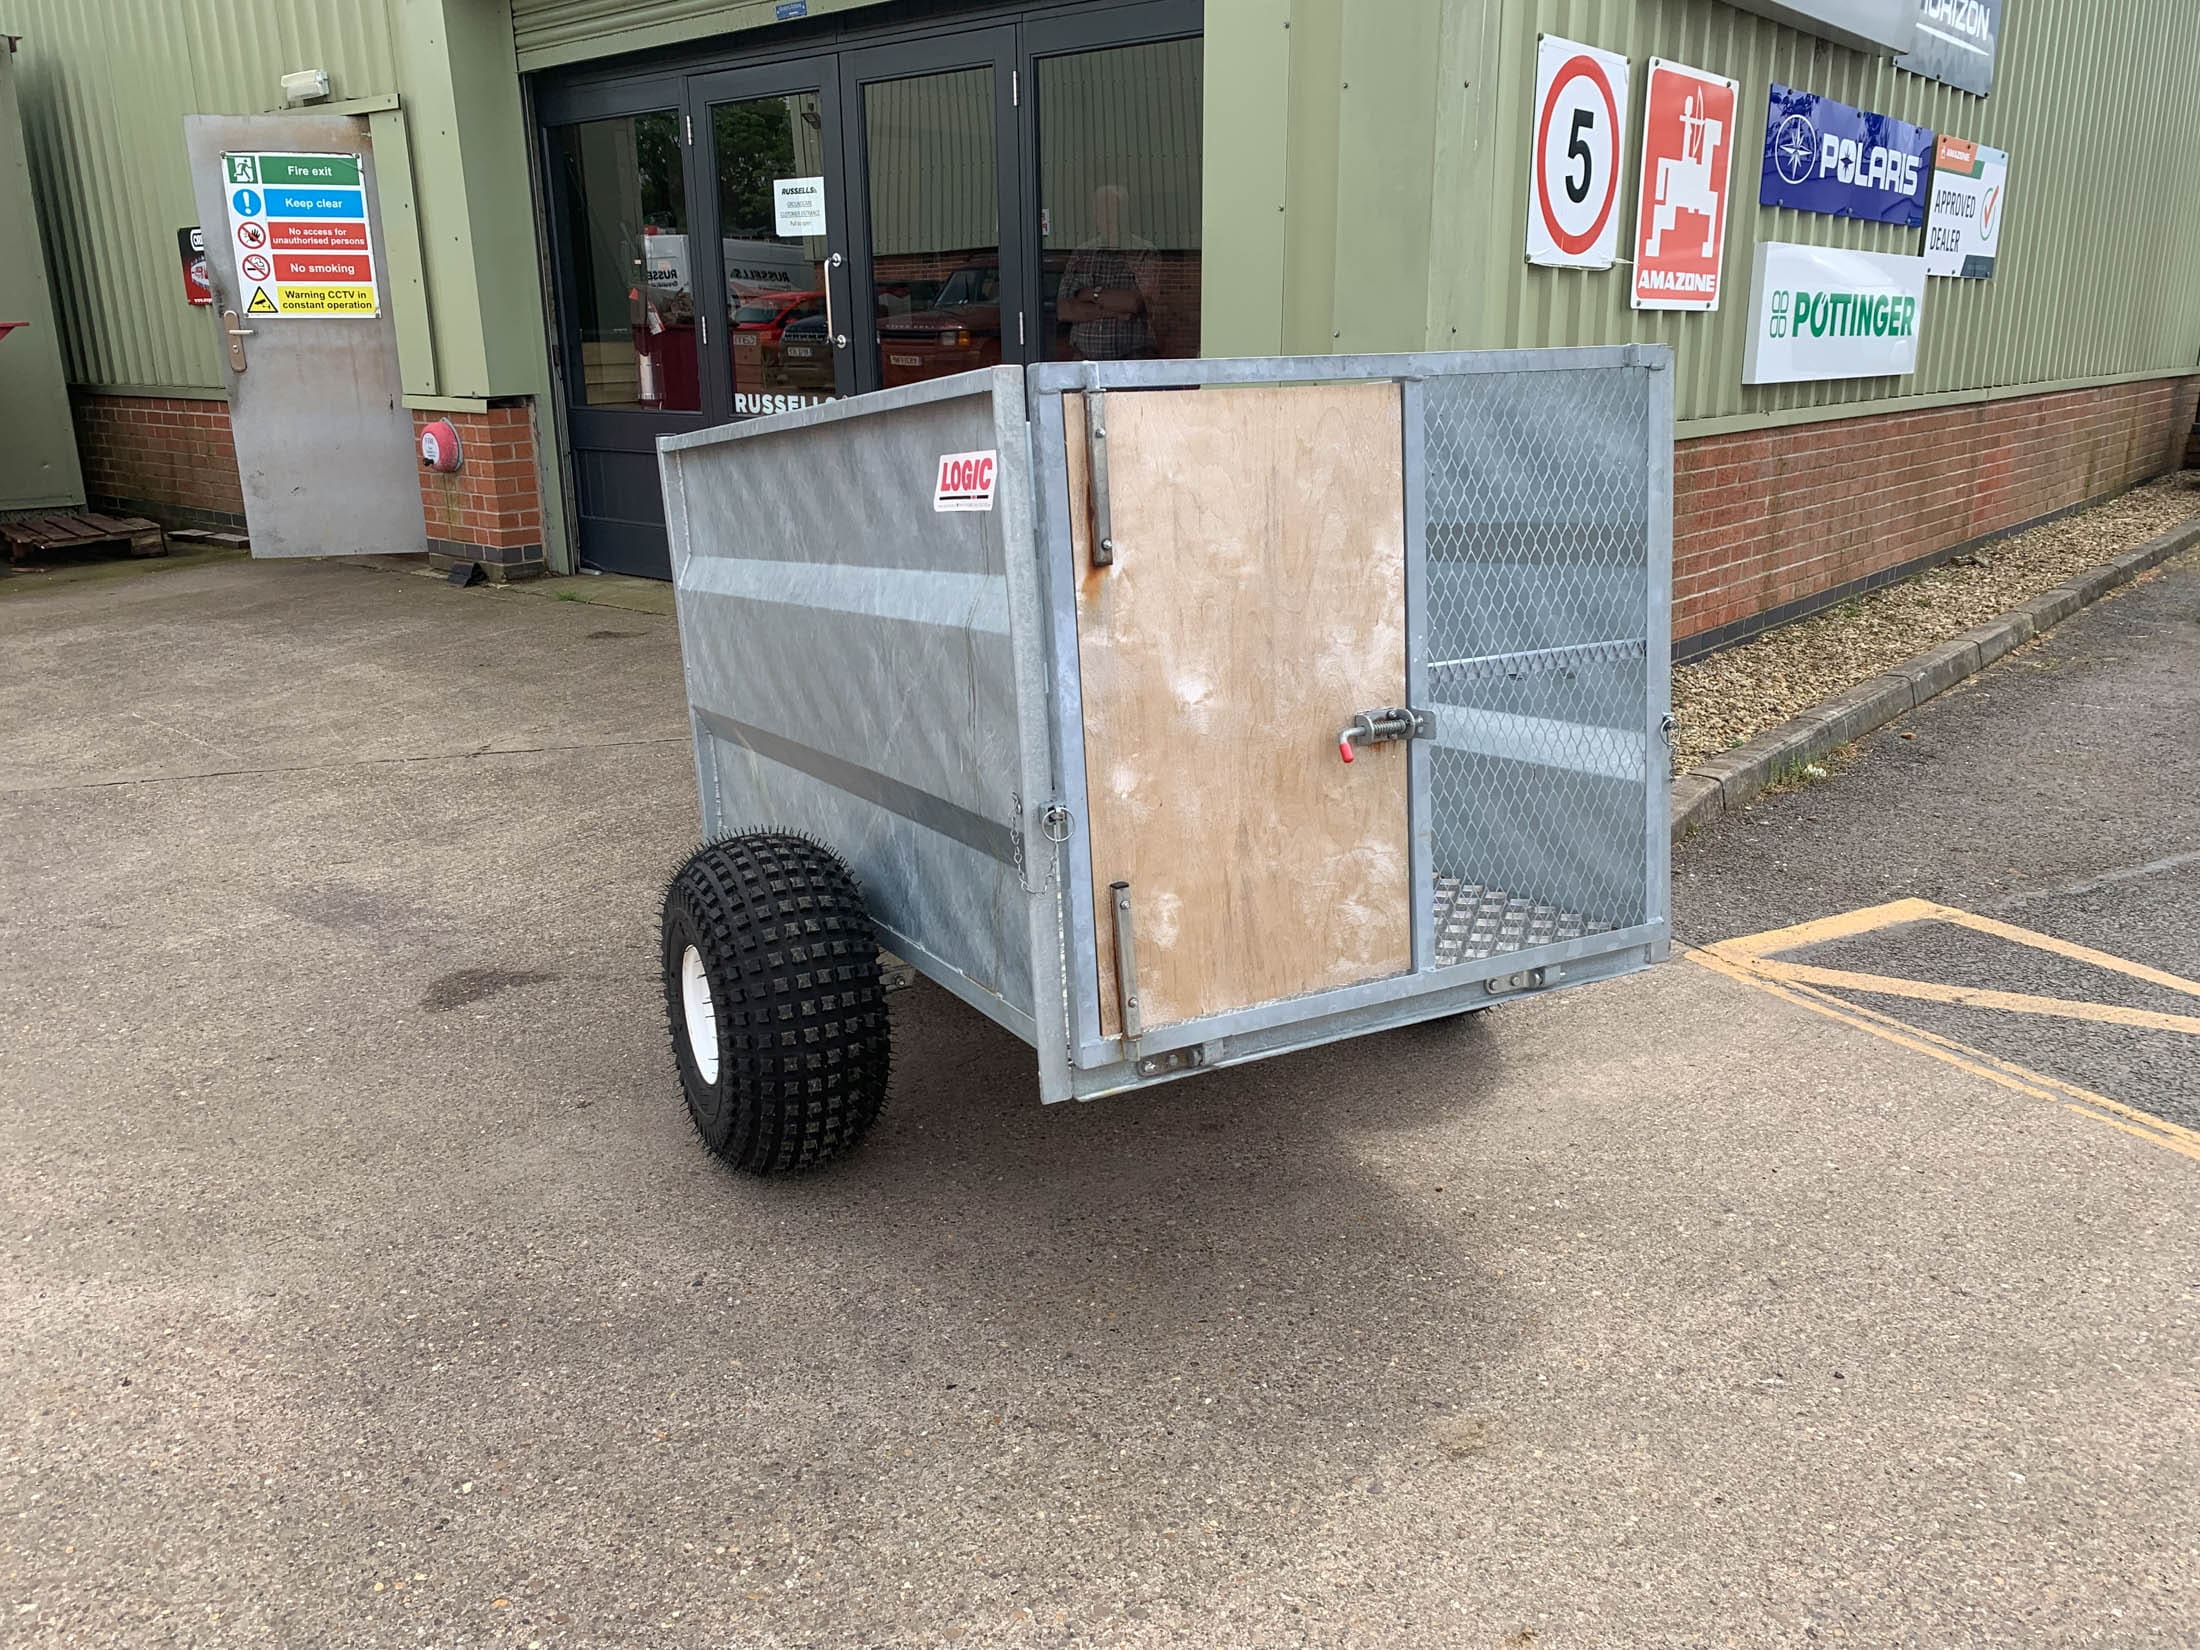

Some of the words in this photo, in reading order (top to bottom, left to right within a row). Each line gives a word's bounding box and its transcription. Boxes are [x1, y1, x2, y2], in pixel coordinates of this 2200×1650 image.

[1565, 108, 1594, 203] 5
[1819, 133, 1920, 196] POLARIS
[287, 165, 309, 176] Fire
[312, 166, 333, 177] exit
[781, 186, 815, 195] RUSSELLS
[285, 198, 313, 210] Keep
[316, 198, 343, 208] clear
[1934, 189, 1976, 218] APPROVED
[288, 227, 301, 235] No
[303, 228, 332, 236] access
[334, 228, 347, 236] for
[272, 237, 328, 245] unauthorised
[330, 237, 365, 246] persons
[1930, 227, 1960, 252] DEALER
[290, 263, 306, 273] No
[309, 263, 355, 275] smoking
[1638, 269, 1716, 292] AMAZONE
[285, 291, 325, 300] Warning
[327, 291, 354, 299] CCTV
[357, 290, 366, 299] in
[282, 301, 324, 309] constant
[327, 301, 372, 310] operation
[940, 457, 993, 492] LOGIC
